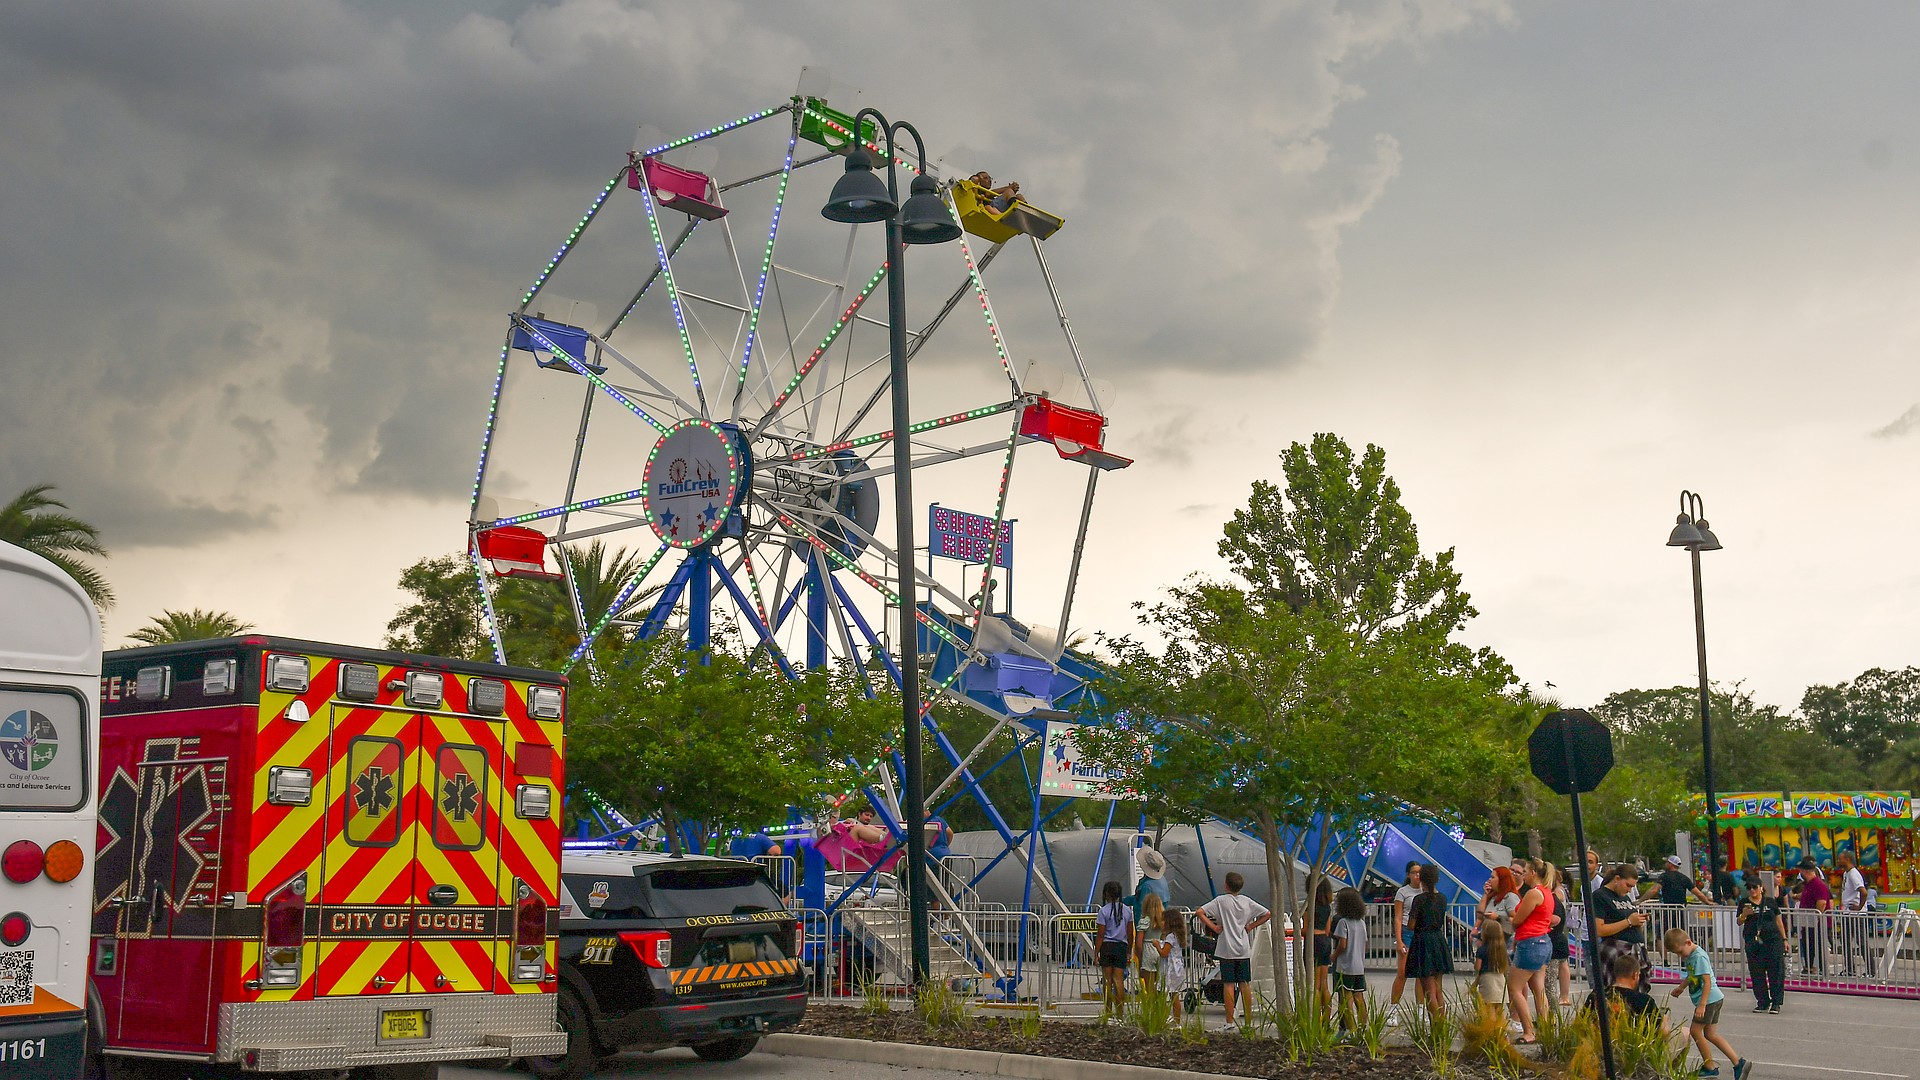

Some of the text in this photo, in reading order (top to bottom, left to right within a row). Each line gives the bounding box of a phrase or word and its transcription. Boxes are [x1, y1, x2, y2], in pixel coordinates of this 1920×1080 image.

[658, 478, 720, 496] FunCrew
[701, 489, 720, 498] USA
[934, 508, 1010, 544] SUGAR
[9, 773, 23, 781] City
[1701, 794, 1904, 818] TER GUN FUN!
[332, 913, 485, 931] CITY OF OCOEE
[686, 911, 790, 927] OCOEE POLICE
[586, 937, 617, 947] DIAL
[580, 946, 613, 964] 911
[674, 985, 692, 995] 1319
[720, 979, 768, 990] www.ocoee.org
[0, 1038, 46, 1061] 1161
